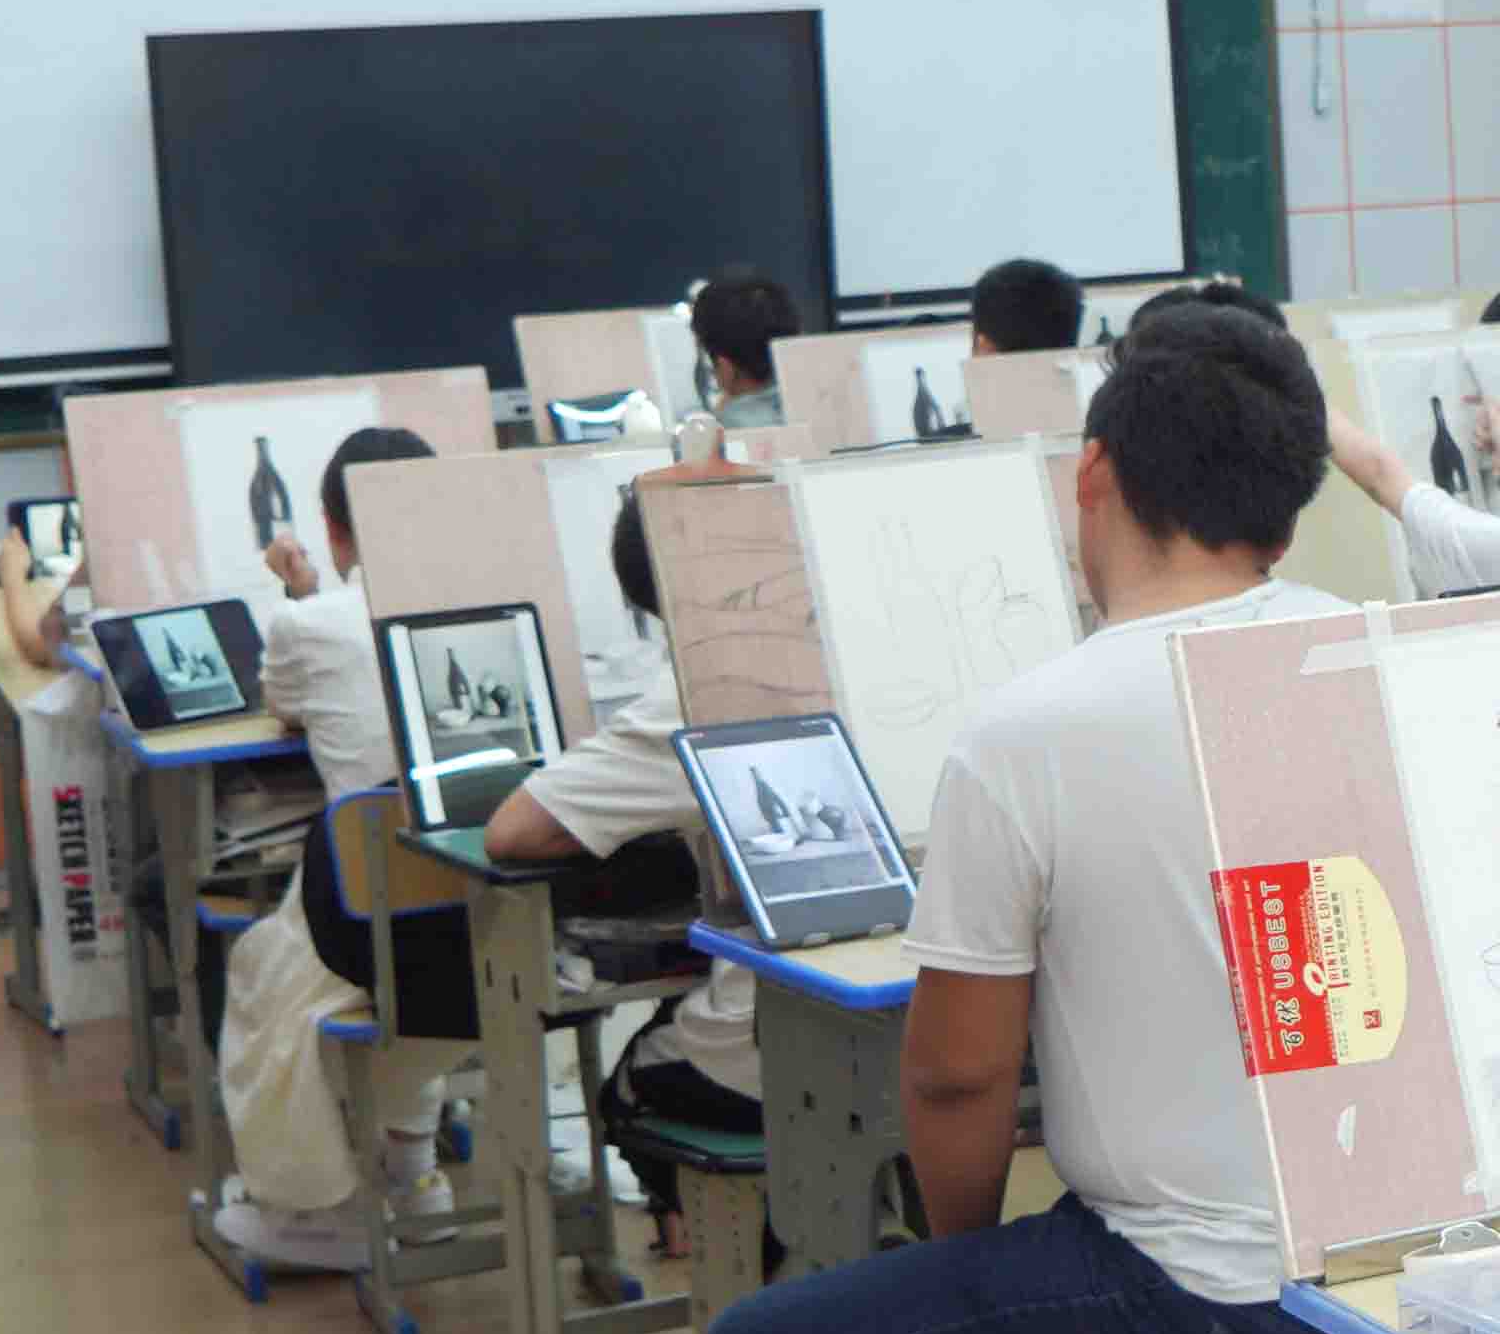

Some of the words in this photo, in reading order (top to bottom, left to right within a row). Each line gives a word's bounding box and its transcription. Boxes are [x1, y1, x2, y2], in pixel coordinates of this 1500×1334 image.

[1312, 860, 1332, 921] EDITION
[1259, 880, 1296, 990] USBEST
[1275, 996, 1305, 1057] 百优
